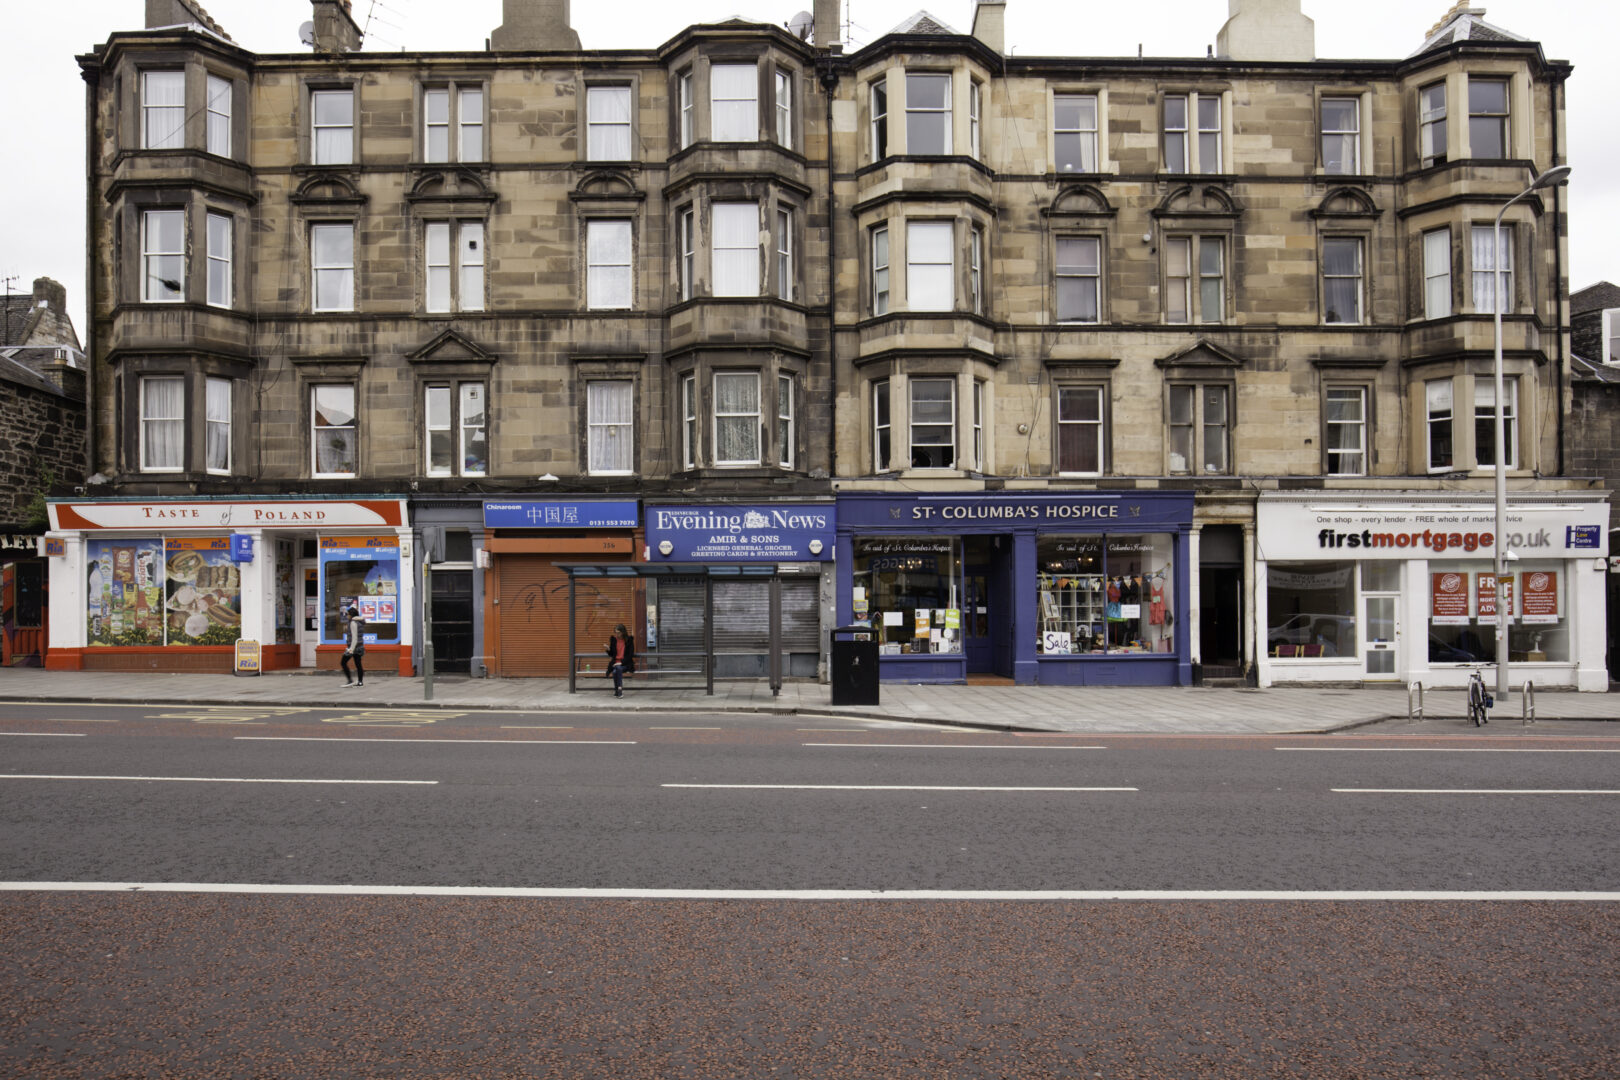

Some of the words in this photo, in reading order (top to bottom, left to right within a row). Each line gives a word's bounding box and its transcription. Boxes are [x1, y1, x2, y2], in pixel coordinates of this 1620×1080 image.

[142, 507, 199, 518] TASTE
[220, 505, 232, 526] of
[254, 509, 326, 520] POLAND
[527, 506, 579, 524] 中国屋
[942, 505, 1039, 519] COLUMBA'S
[1046, 505, 1118, 518] HOSPICE
[656, 510, 741, 534] Evening
[771, 510, 826, 529] News
[1334, 515, 1352, 525] shop
[1361, 517, 1381, 525] every
[1384, 515, 1406, 523] lender
[1438, 515, 1458, 523] whole
[1462, 515, 1469, 523] of
[167, 539, 182, 548] Ria
[210, 539, 227, 548] Ria
[322, 539, 337, 547] Ria
[366, 538, 382, 547] Ria
[751, 535, 779, 543] SONS
[47, 540, 63, 553] Ria
[1045, 634, 1069, 650] Sale
[240, 658, 257, 667] Ria
